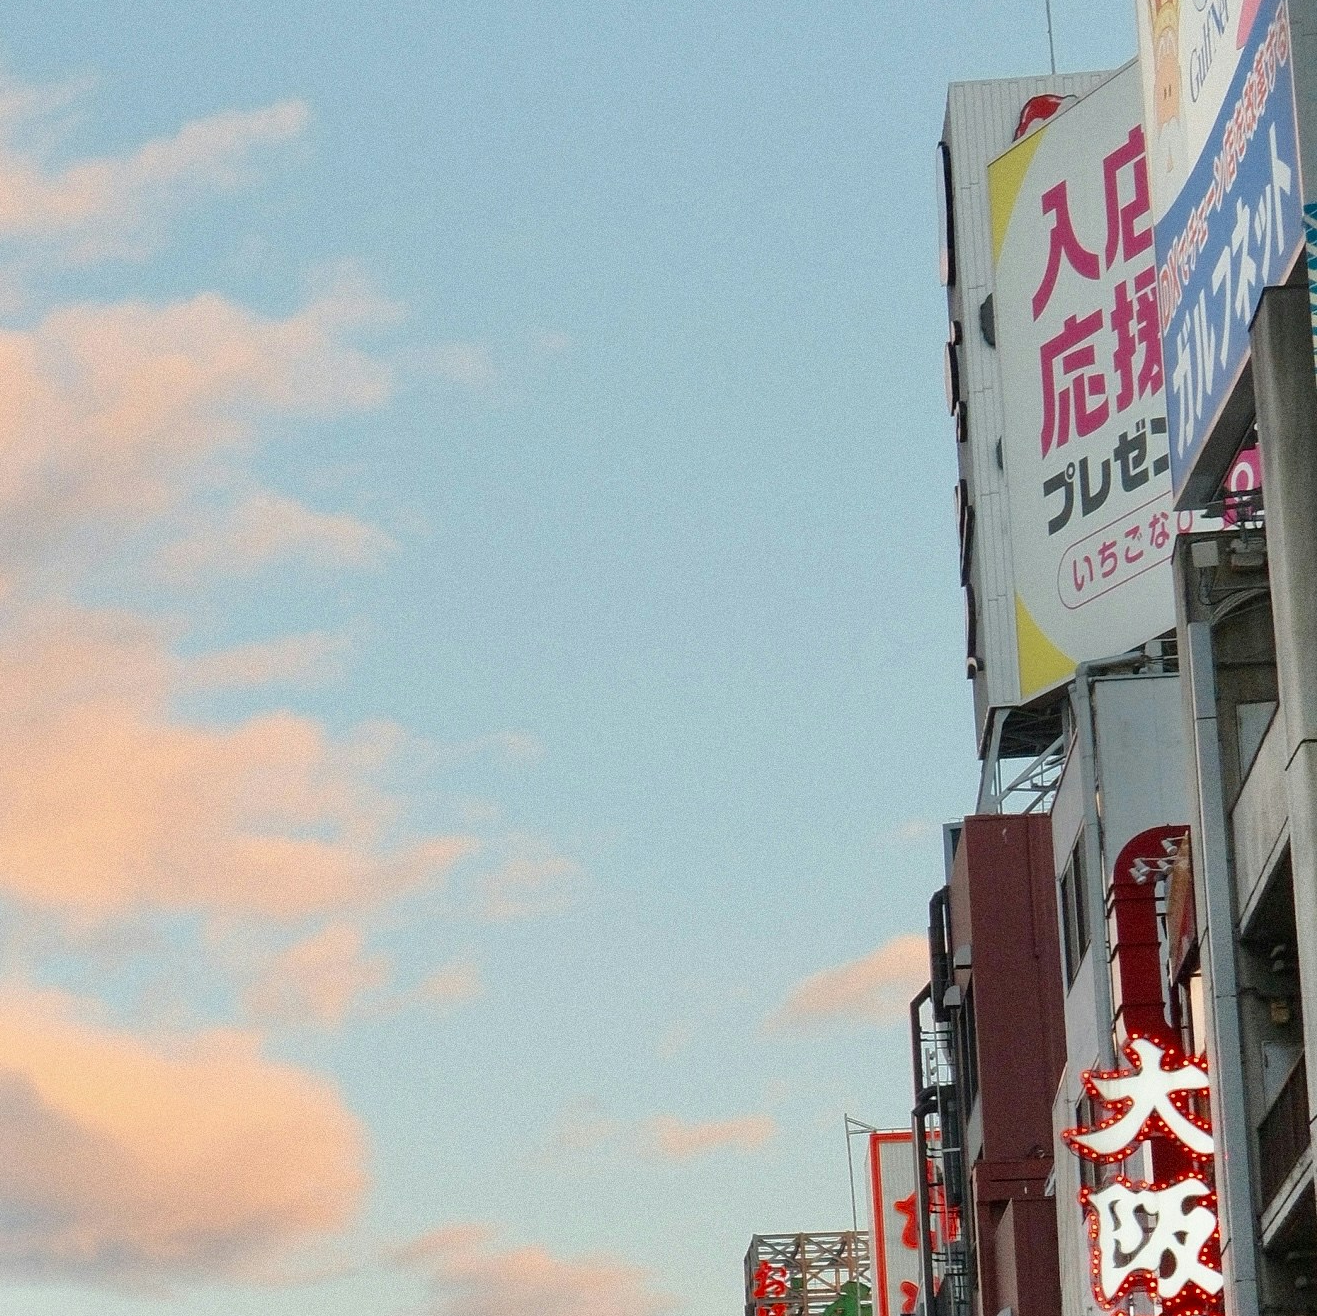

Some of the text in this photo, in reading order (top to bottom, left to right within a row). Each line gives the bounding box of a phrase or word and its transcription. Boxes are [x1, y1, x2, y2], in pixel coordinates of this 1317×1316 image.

[1172, 123, 1294, 449] ガルフネット
